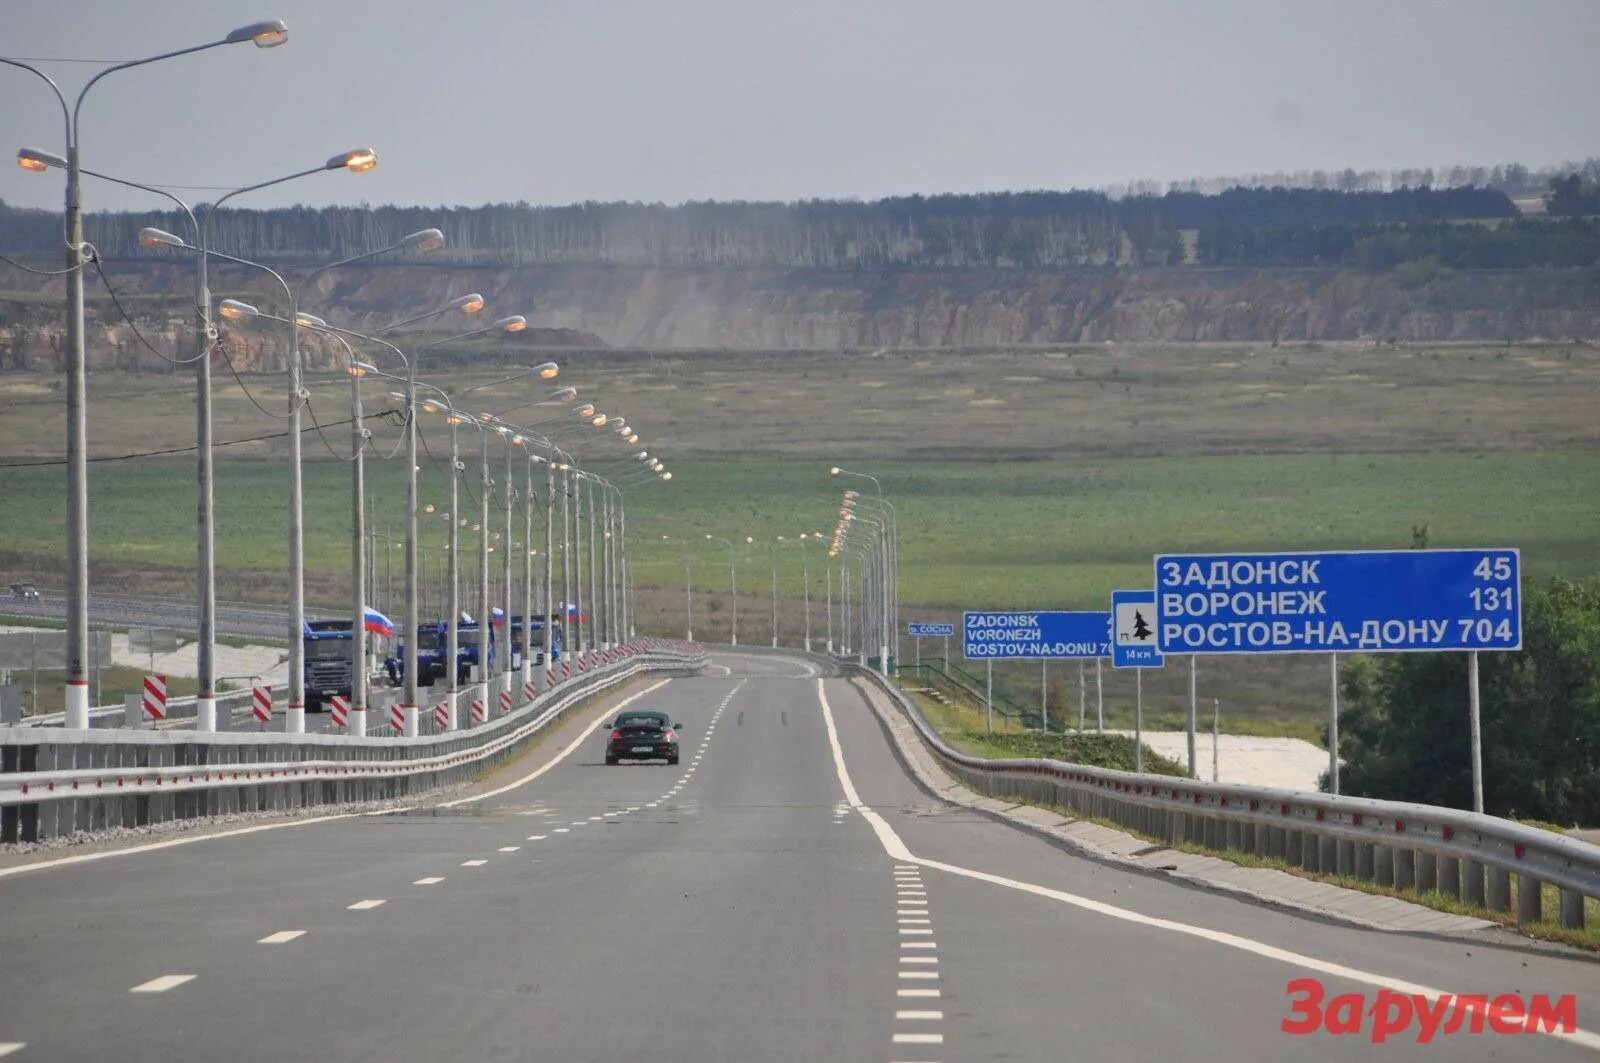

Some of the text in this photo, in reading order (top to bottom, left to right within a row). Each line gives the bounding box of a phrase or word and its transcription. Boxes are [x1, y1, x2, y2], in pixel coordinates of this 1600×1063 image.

[1162, 556, 1512, 589] ЗАДОНСК 45
[1163, 587, 1513, 616] ВОРОНЕЖ 131
[967, 615, 1039, 627] ZADONSK
[967, 629, 1041, 641] VORONEZH
[1163, 618, 1512, 648] РОСТОВ-НА-ДОНУ 704
[967, 642, 1096, 655] ROSTOV-NA-DONU
